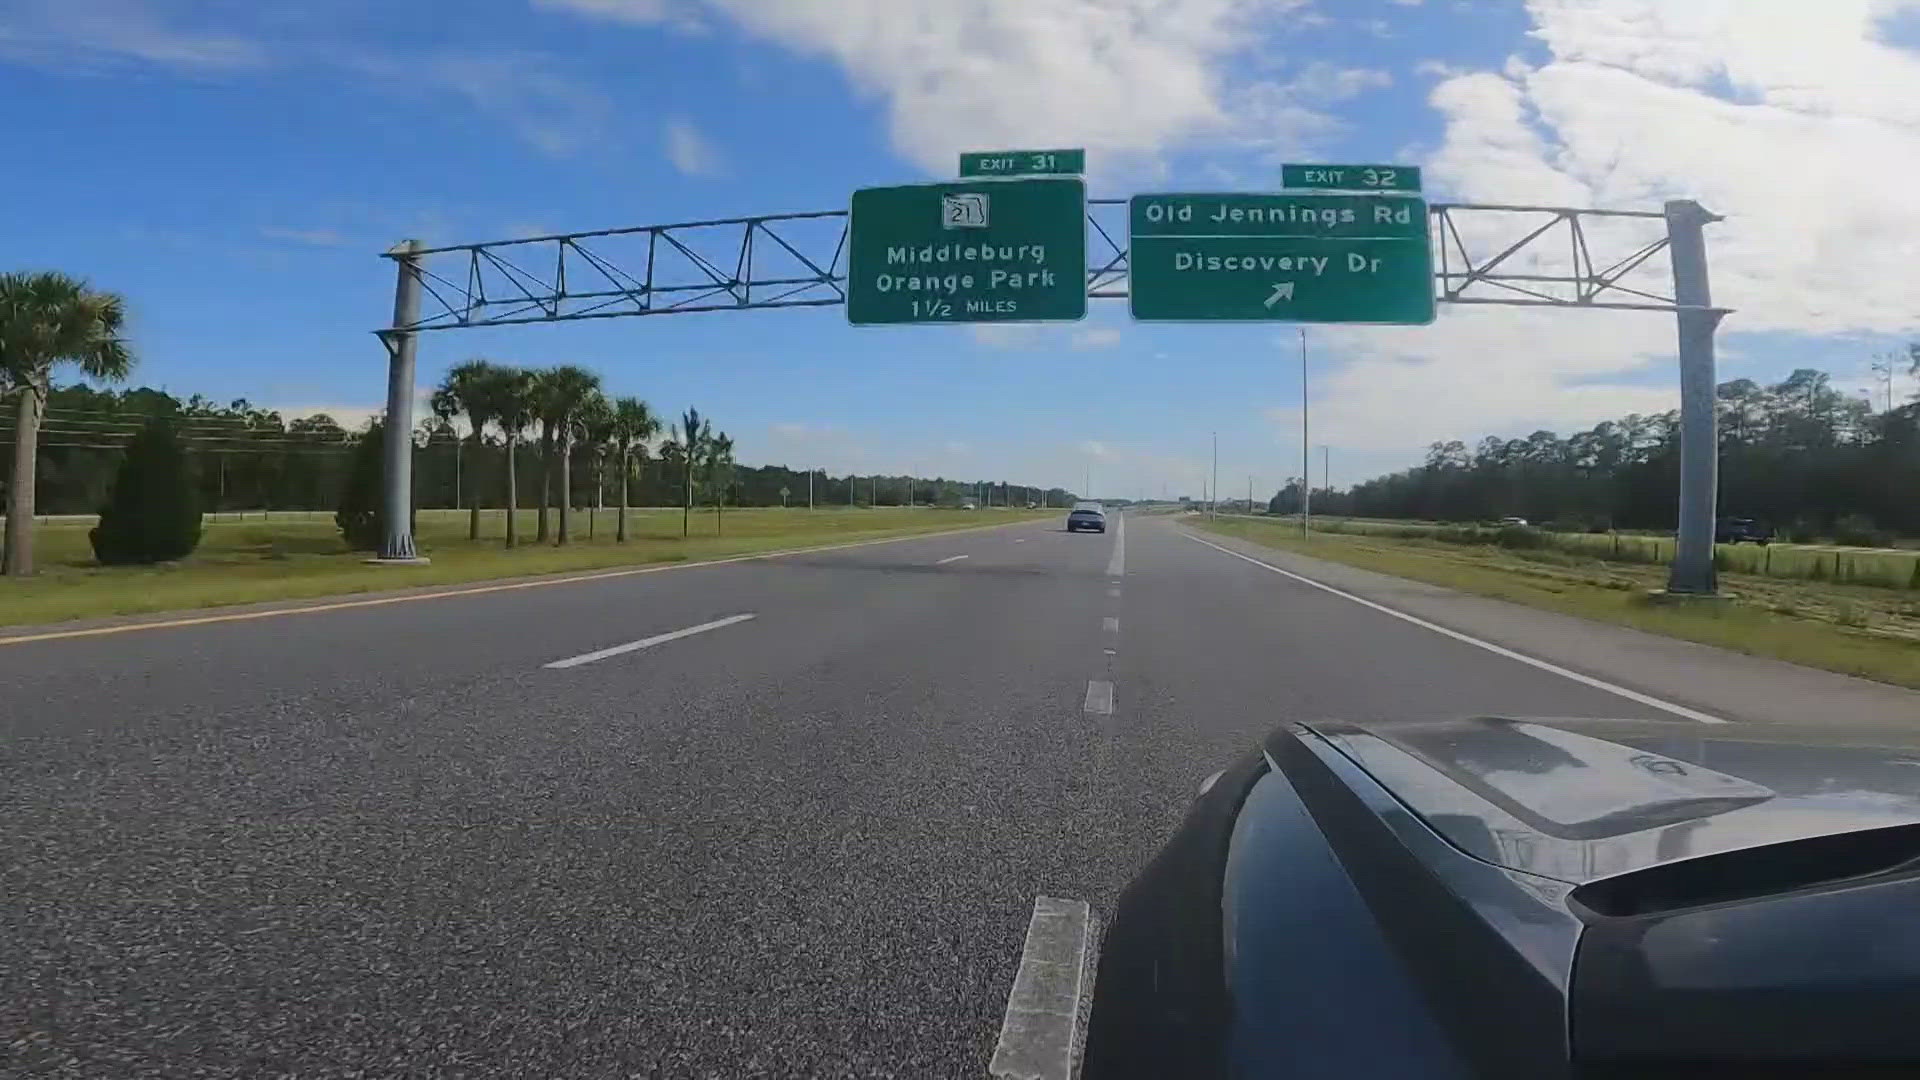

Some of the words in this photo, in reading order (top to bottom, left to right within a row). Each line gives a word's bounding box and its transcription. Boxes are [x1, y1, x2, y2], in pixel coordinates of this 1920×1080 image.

[979, 158, 1014, 170] EXIT
[1031, 154, 1055, 170] 31
[1304, 170, 1344, 184] EXIT
[1361, 169, 1397, 186] 32
[951, 205, 971, 224] 21
[1145, 204, 1192, 223] Old
[1209, 204, 1355, 228] Jennings
[1373, 204, 1411, 224] Rd
[887, 243, 1045, 265] Middleburg
[1175, 252, 1328, 275] Discovery
[1348, 252, 1381, 273] Dr
[876, 273, 974, 294] Orange
[990, 269, 1056, 289] Park
[966, 300, 1017, 313] MILES
